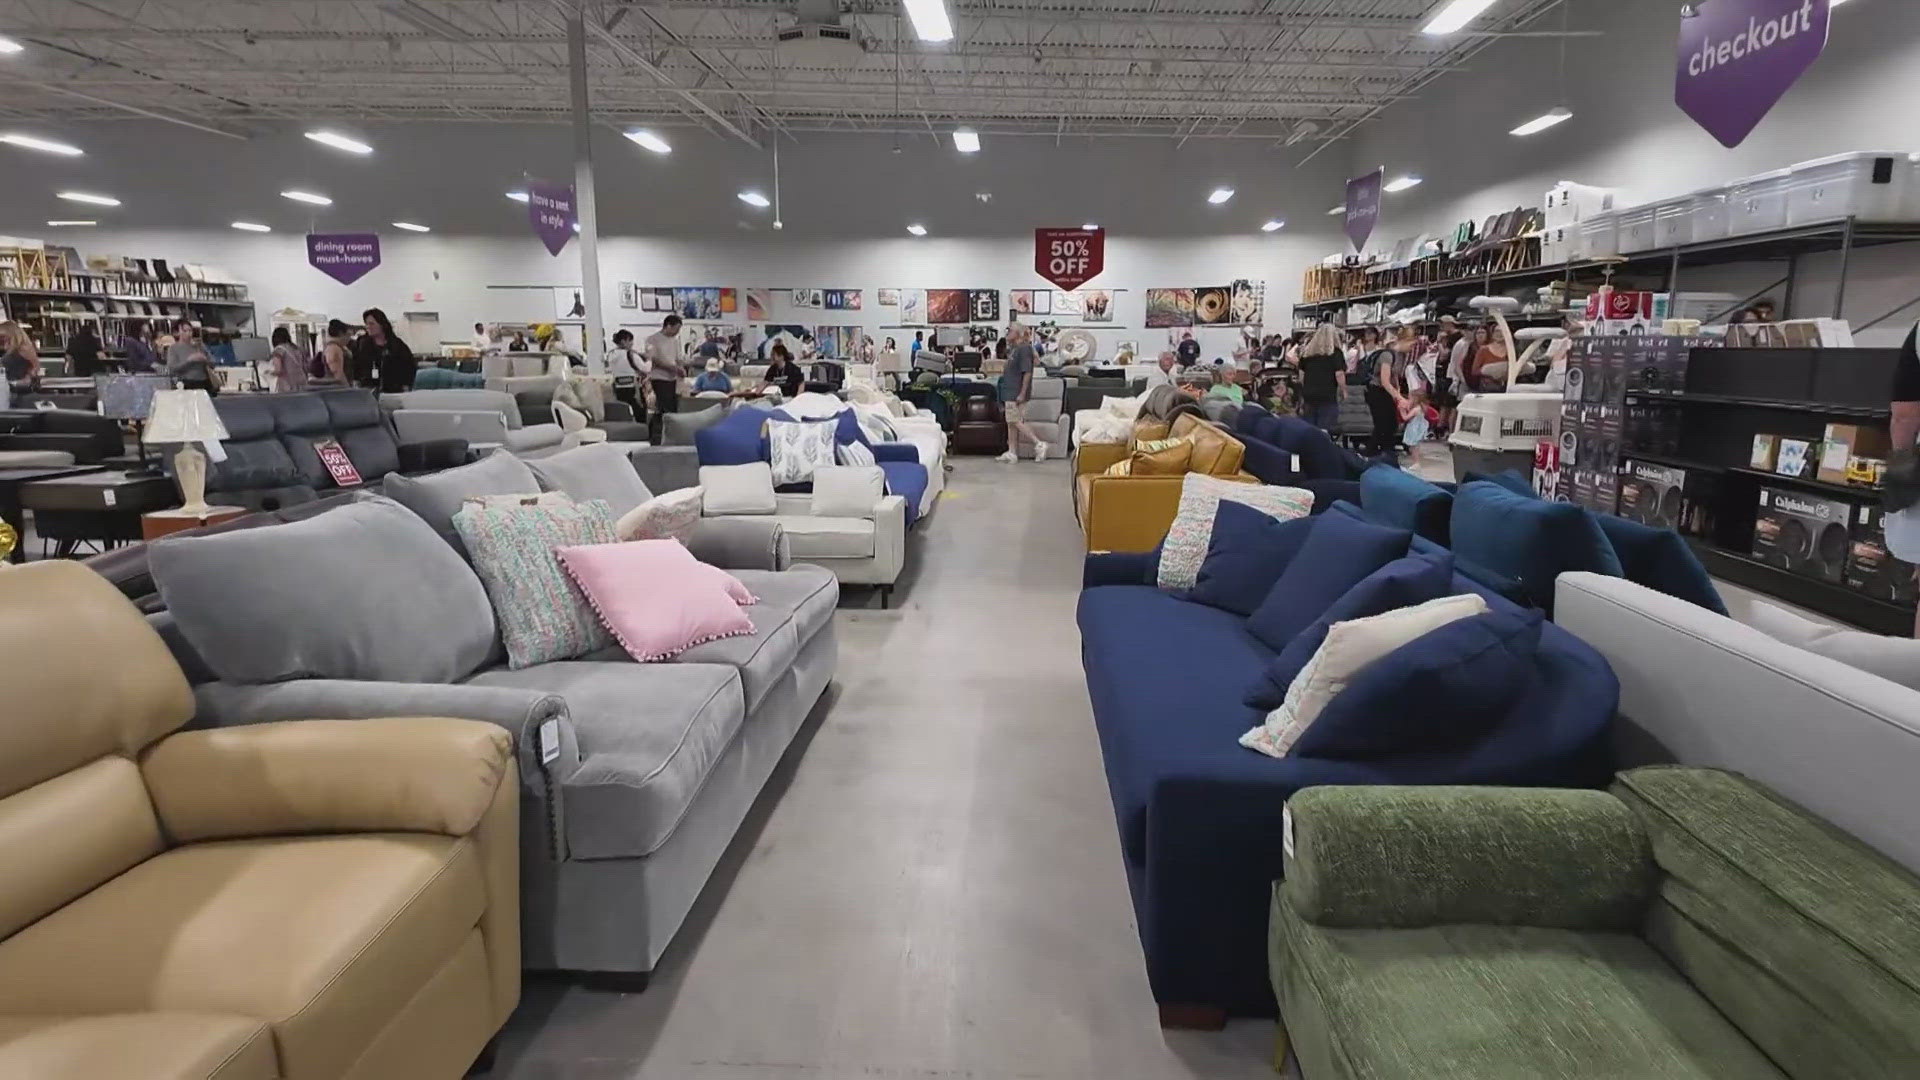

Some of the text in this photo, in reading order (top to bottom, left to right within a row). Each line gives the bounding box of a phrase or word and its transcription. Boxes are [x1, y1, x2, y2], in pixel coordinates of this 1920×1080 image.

[1688, 0, 1813, 76] checkout
[314, 241, 373, 254] dining room
[1051, 240, 1089, 256] 50%
[316, 253, 374, 264] must-haves
[1050, 258, 1089, 275] OFF
[331, 464, 353, 476] OFF
